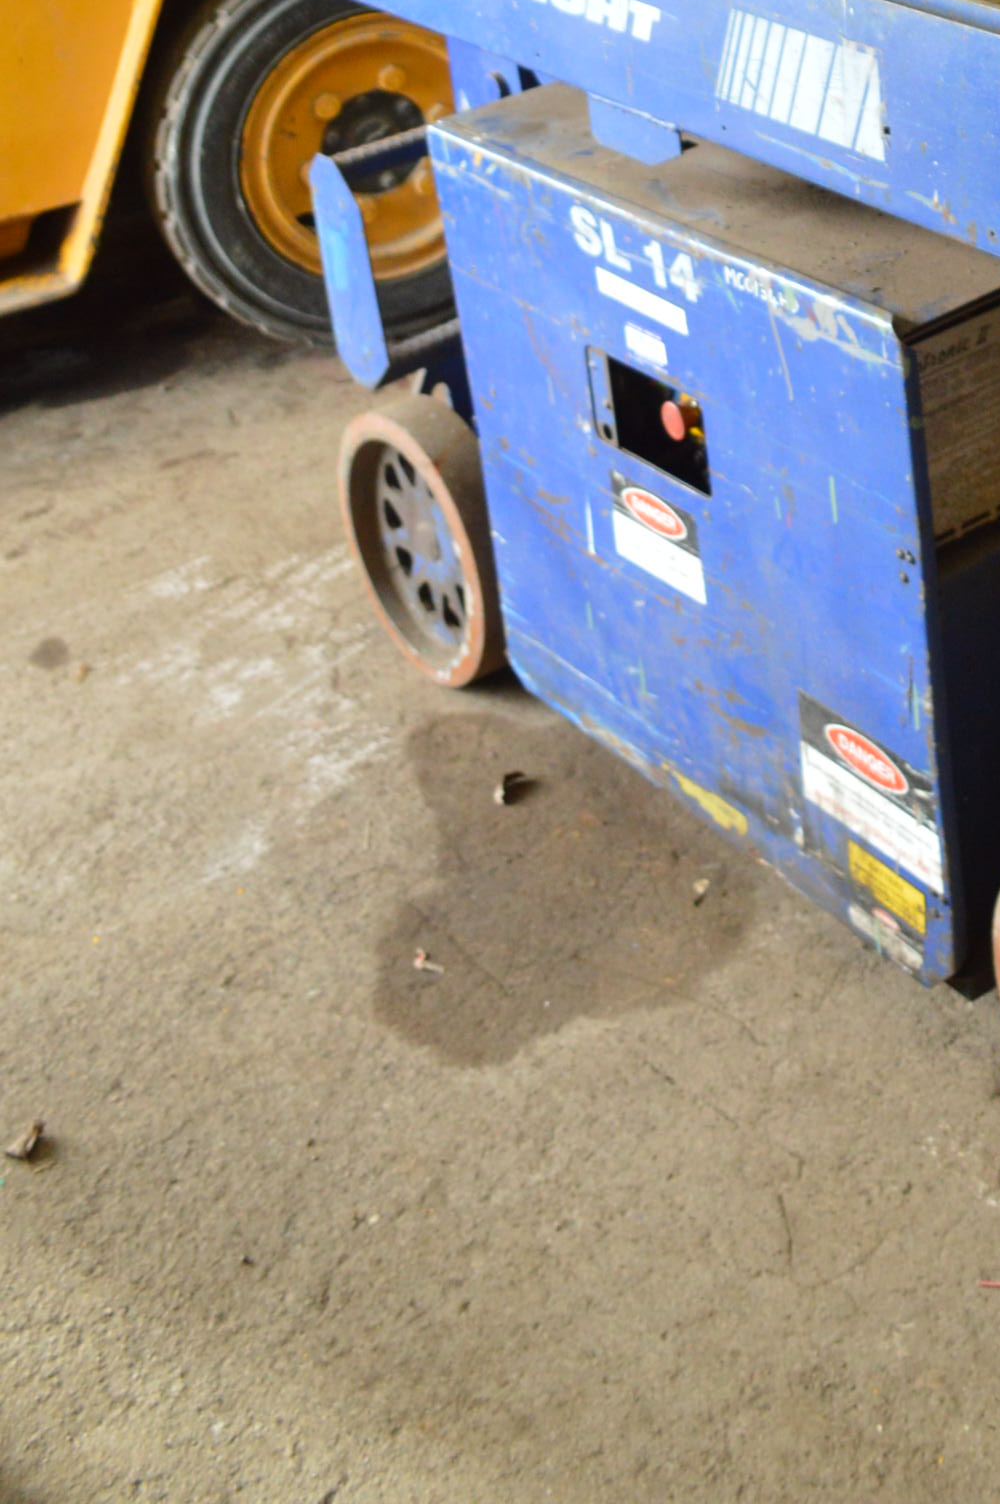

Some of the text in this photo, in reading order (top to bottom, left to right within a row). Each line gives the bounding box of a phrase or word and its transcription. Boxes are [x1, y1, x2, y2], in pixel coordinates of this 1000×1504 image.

[570, 204, 702, 303] SL 14
[836, 732, 898, 786] DANGER
